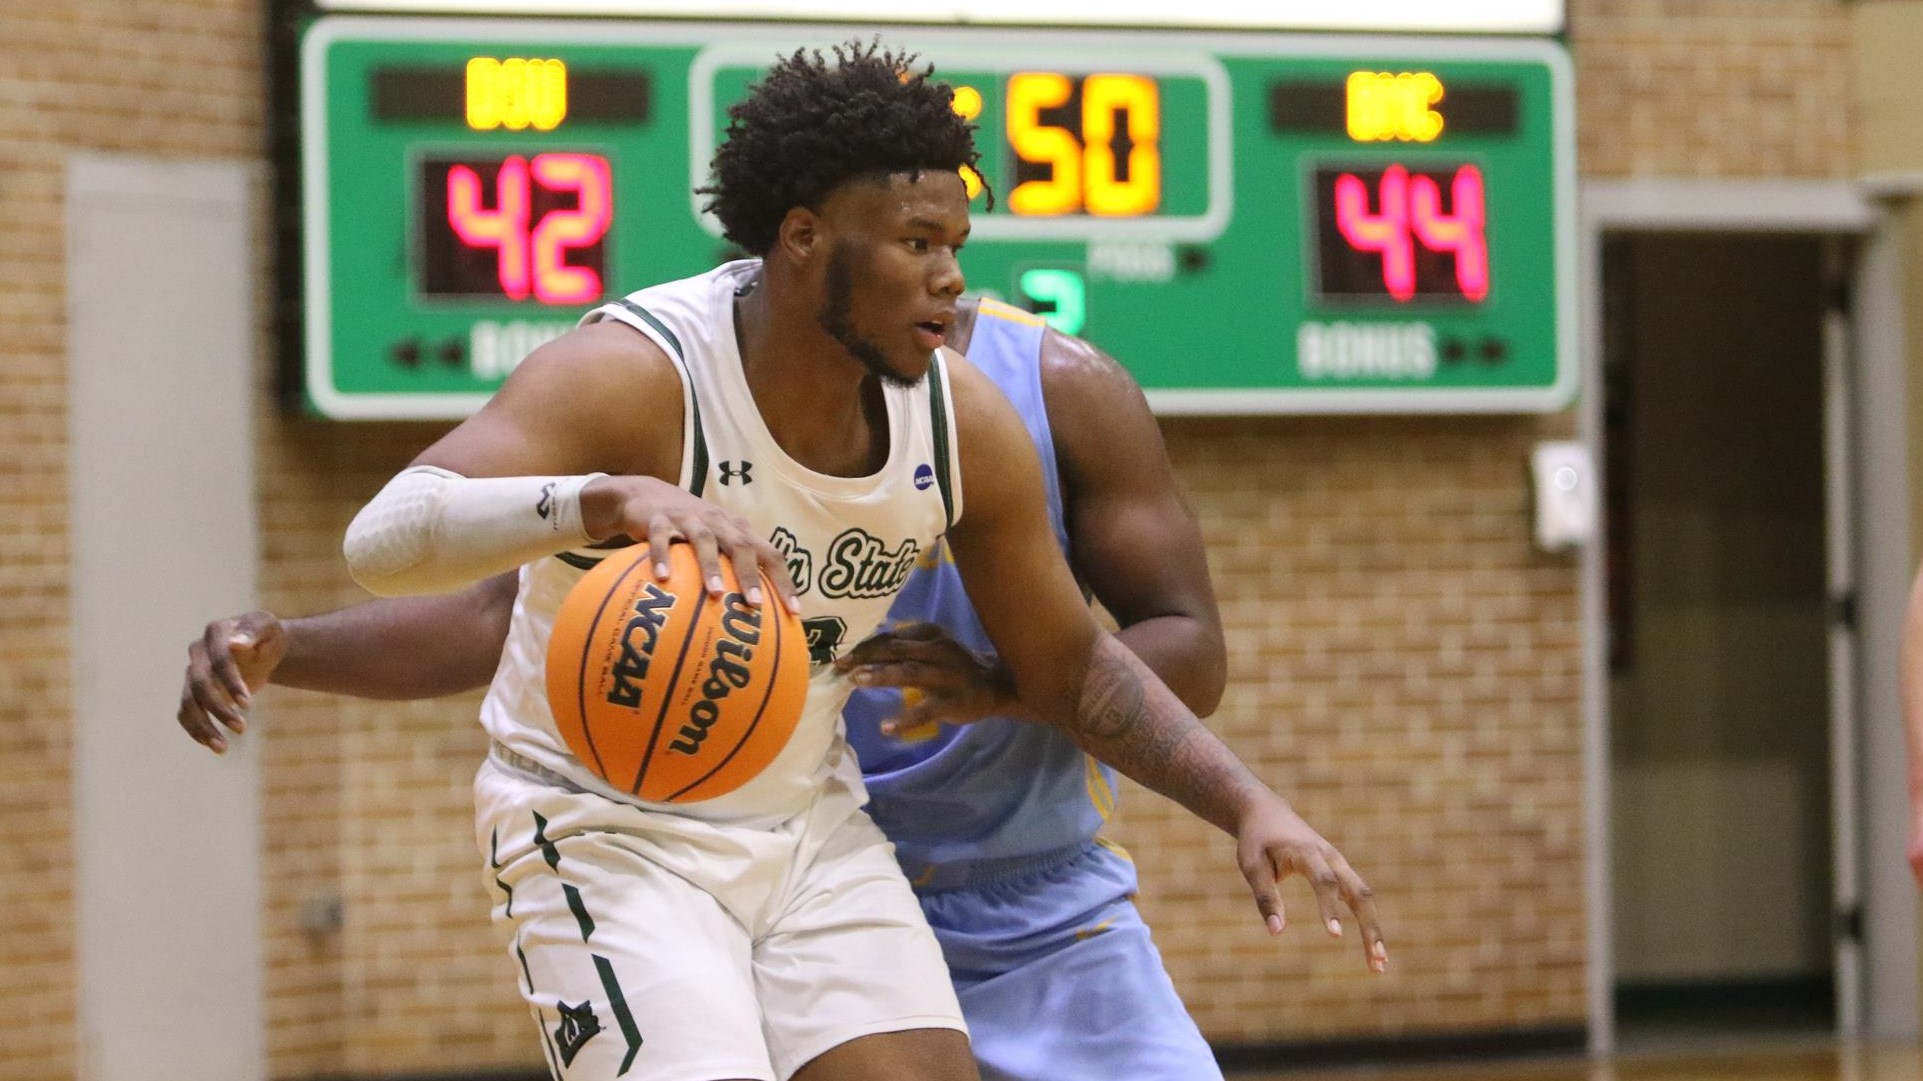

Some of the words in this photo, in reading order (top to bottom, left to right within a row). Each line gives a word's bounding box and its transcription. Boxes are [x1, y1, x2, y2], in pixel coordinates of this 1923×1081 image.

[446, 153, 613, 305] 42
[1334, 163, 1489, 303] 44
[1298, 322, 1437, 378] BONUS
[606, 582, 678, 709] NCAA
[668, 591, 762, 756] Wilson
